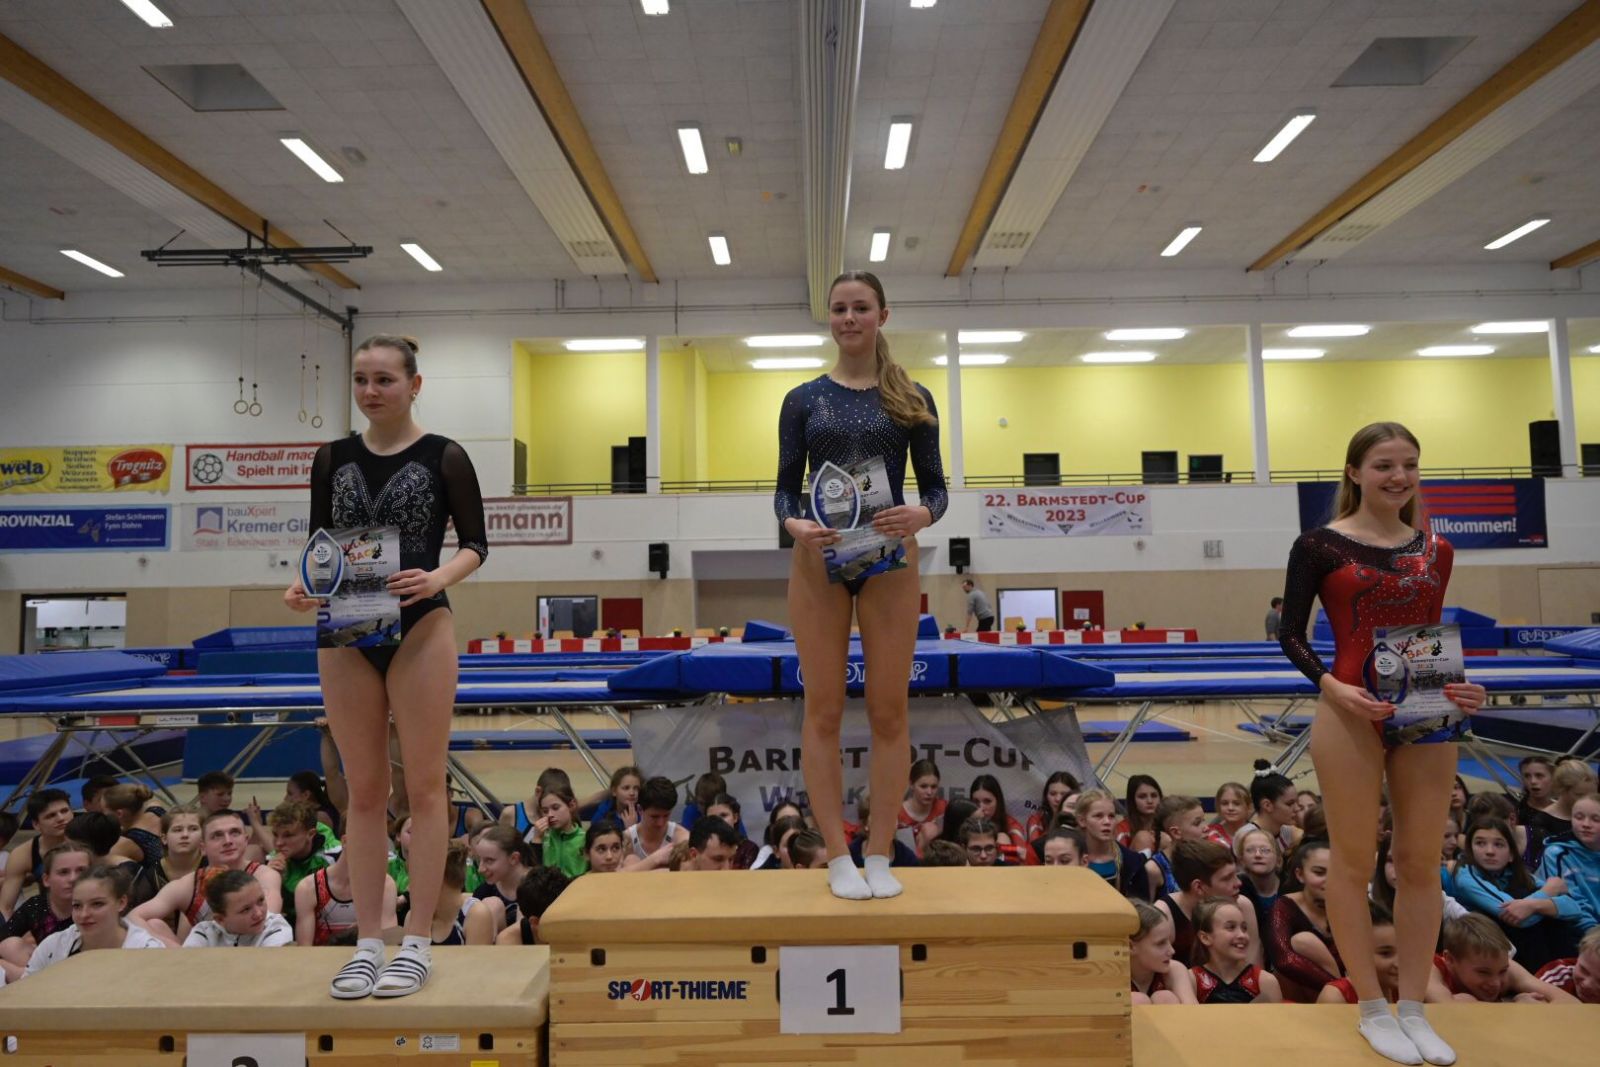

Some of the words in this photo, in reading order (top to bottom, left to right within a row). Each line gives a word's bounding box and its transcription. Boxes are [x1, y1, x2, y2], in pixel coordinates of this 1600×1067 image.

[226, 450, 284, 461] Handball
[0, 460, 45, 475] wela
[115, 459, 163, 475] Trognitz
[237, 465, 274, 478] Spielt
[278, 465, 298, 475] mit
[985, 494, 1011, 507] 22.
[1017, 492, 1145, 507] BARMSTEDT-CUP
[227, 506, 277, 519] bauXpert
[1045, 509, 1086, 522] 2023
[227, 519, 285, 533] Kremer
[488, 512, 563, 530] mann
[1430, 517, 1517, 534] illkommen!
[608, 979, 747, 1001] SPORT-THIEME
[826, 968, 855, 1015] 1
